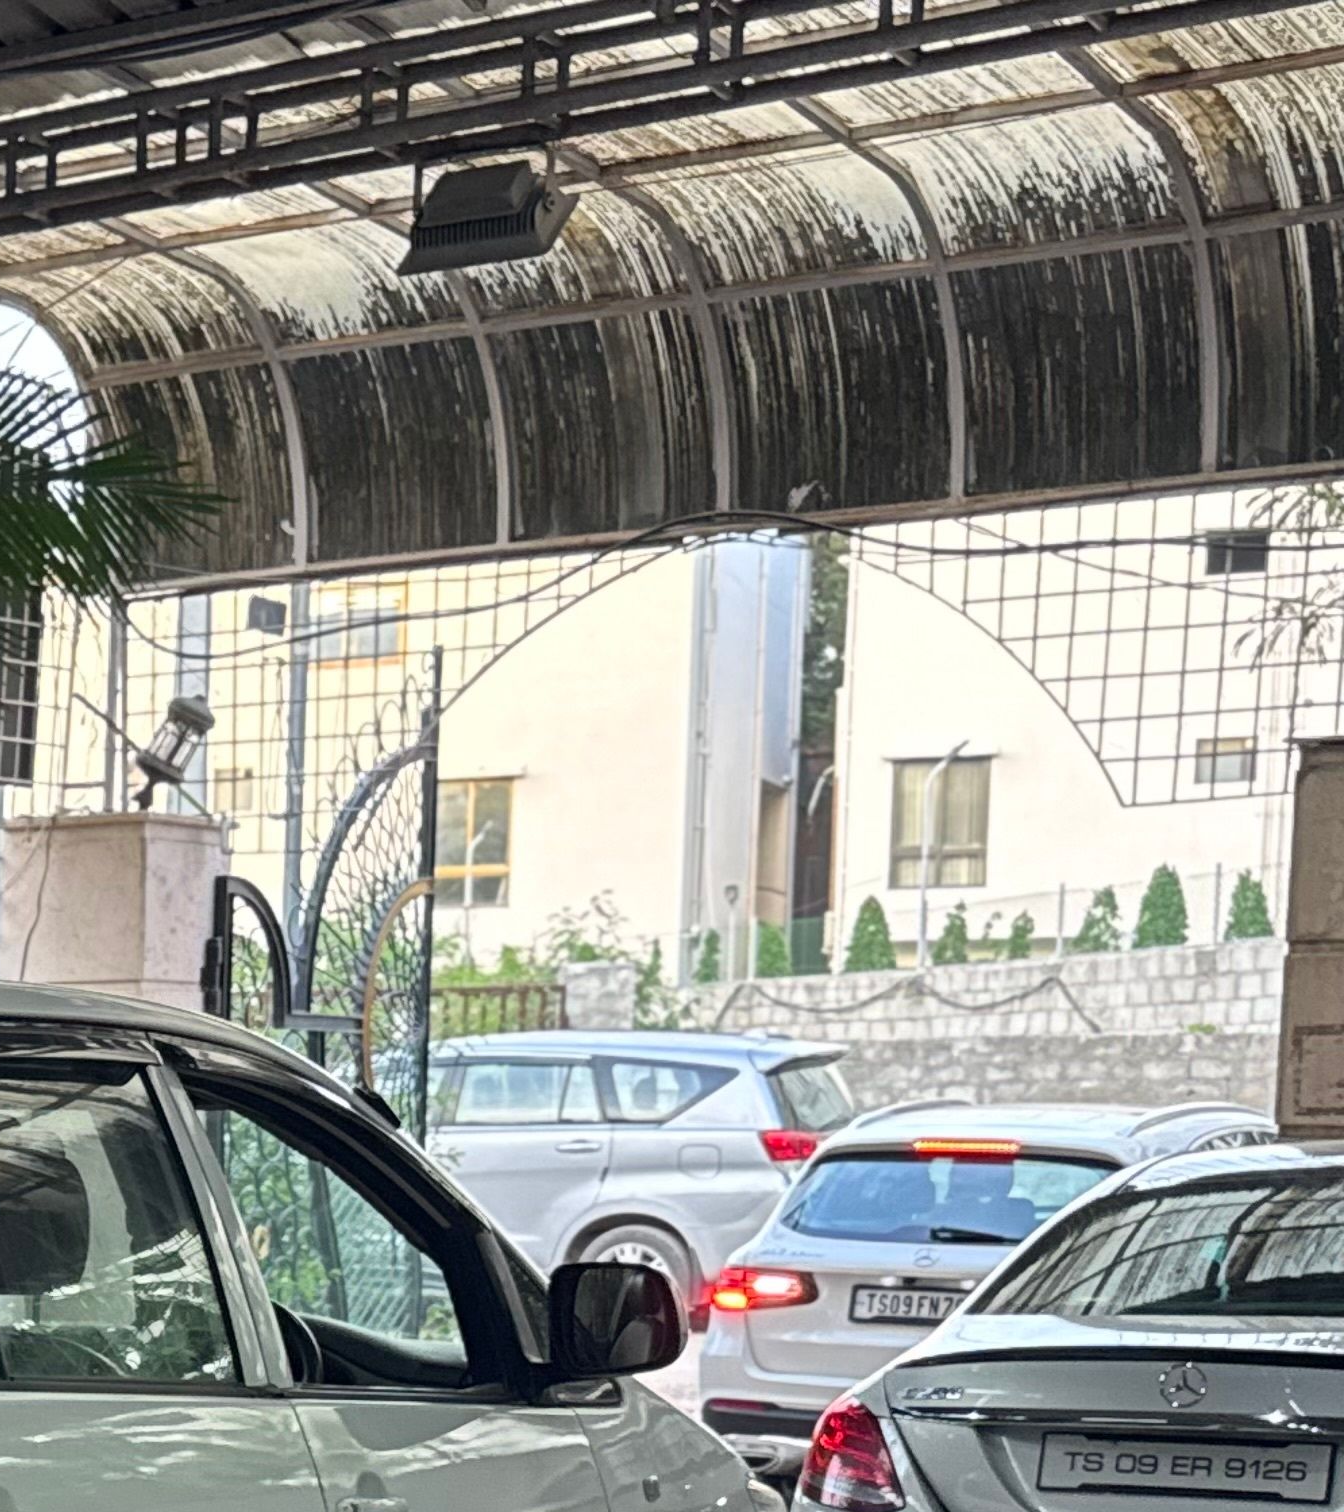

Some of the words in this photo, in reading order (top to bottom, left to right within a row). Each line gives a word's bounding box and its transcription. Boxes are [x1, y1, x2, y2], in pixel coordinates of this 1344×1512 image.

[1063, 1452, 1105, 1473] TS
[1115, 1453, 1159, 1475] 09
[1170, 1455, 1213, 1478] ER
[1224, 1457, 1308, 1482] 9126
